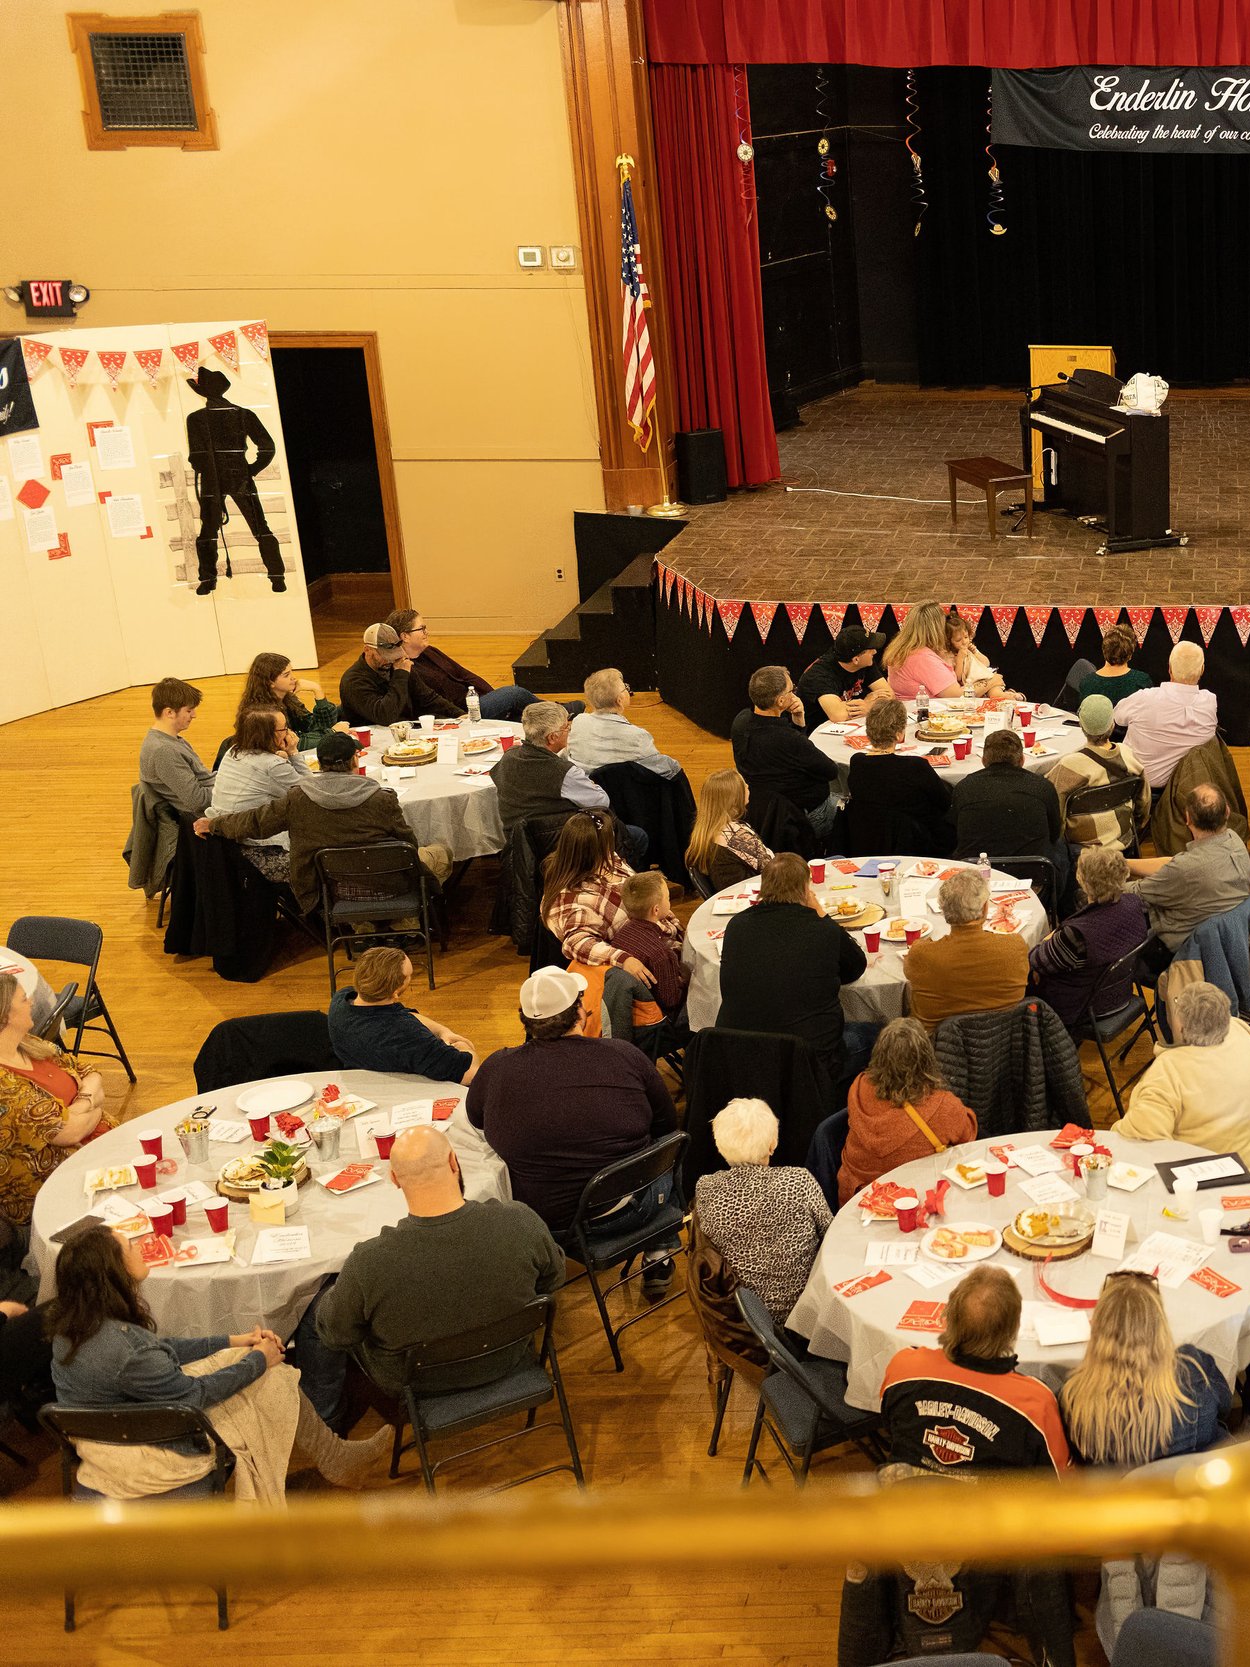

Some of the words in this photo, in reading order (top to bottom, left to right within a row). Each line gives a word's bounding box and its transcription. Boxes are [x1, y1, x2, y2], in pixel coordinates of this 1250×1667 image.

[1089, 75, 1198, 112] Enderlin
[1088, 123, 1150, 144] Celebrating
[1152, 124, 1170, 139] the
[1170, 124, 1202, 139] heart
[1204, 126, 1221, 144] of
[1219, 130, 1239, 140] our
[30, 281, 63, 307] EXIT
[915, 1400, 1000, 1440] HARLEY-DAVIDSON
